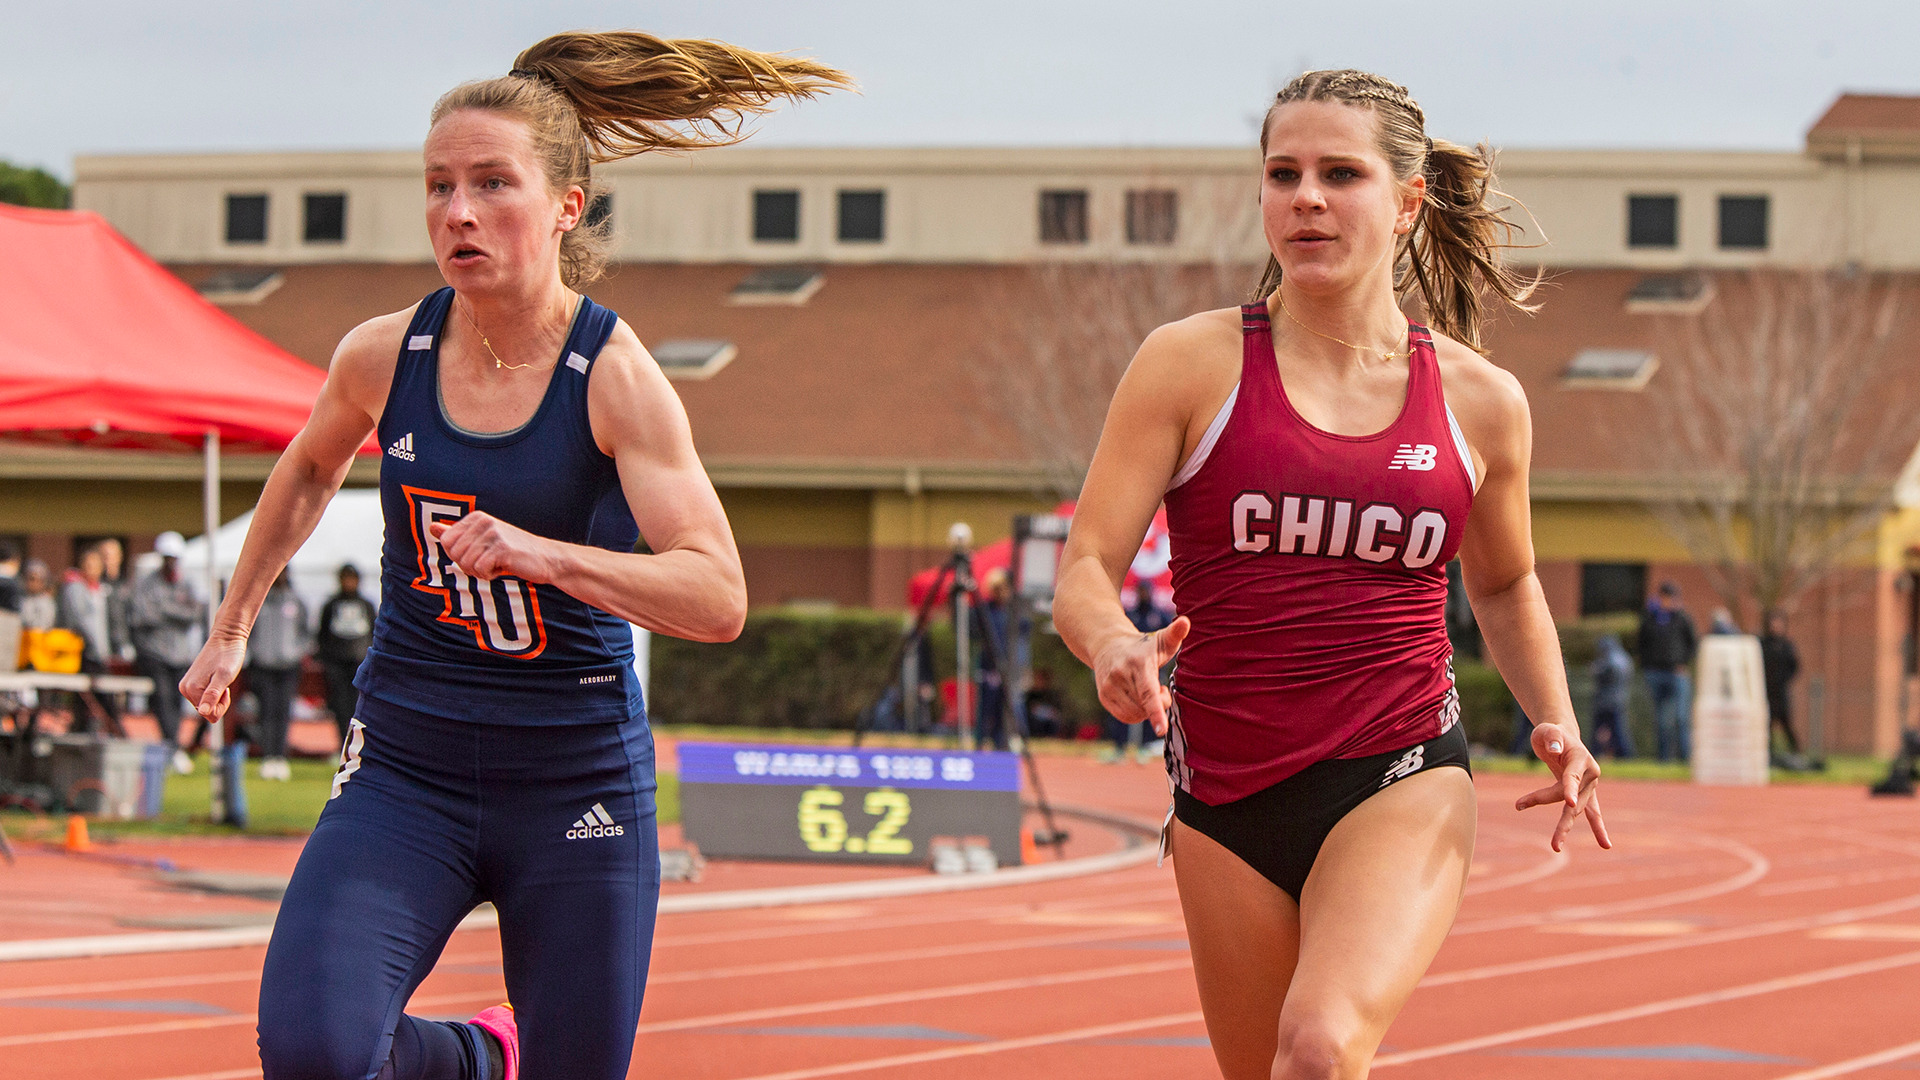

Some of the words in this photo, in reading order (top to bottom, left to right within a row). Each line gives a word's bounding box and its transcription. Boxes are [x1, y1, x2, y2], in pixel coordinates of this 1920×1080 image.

[387, 446, 416, 462] adidas
[1231, 491, 1448, 570] CHICO
[579, 674, 617, 685] AEROREADY
[798, 785, 913, 854] 6.2
[565, 824, 624, 840] adidas
